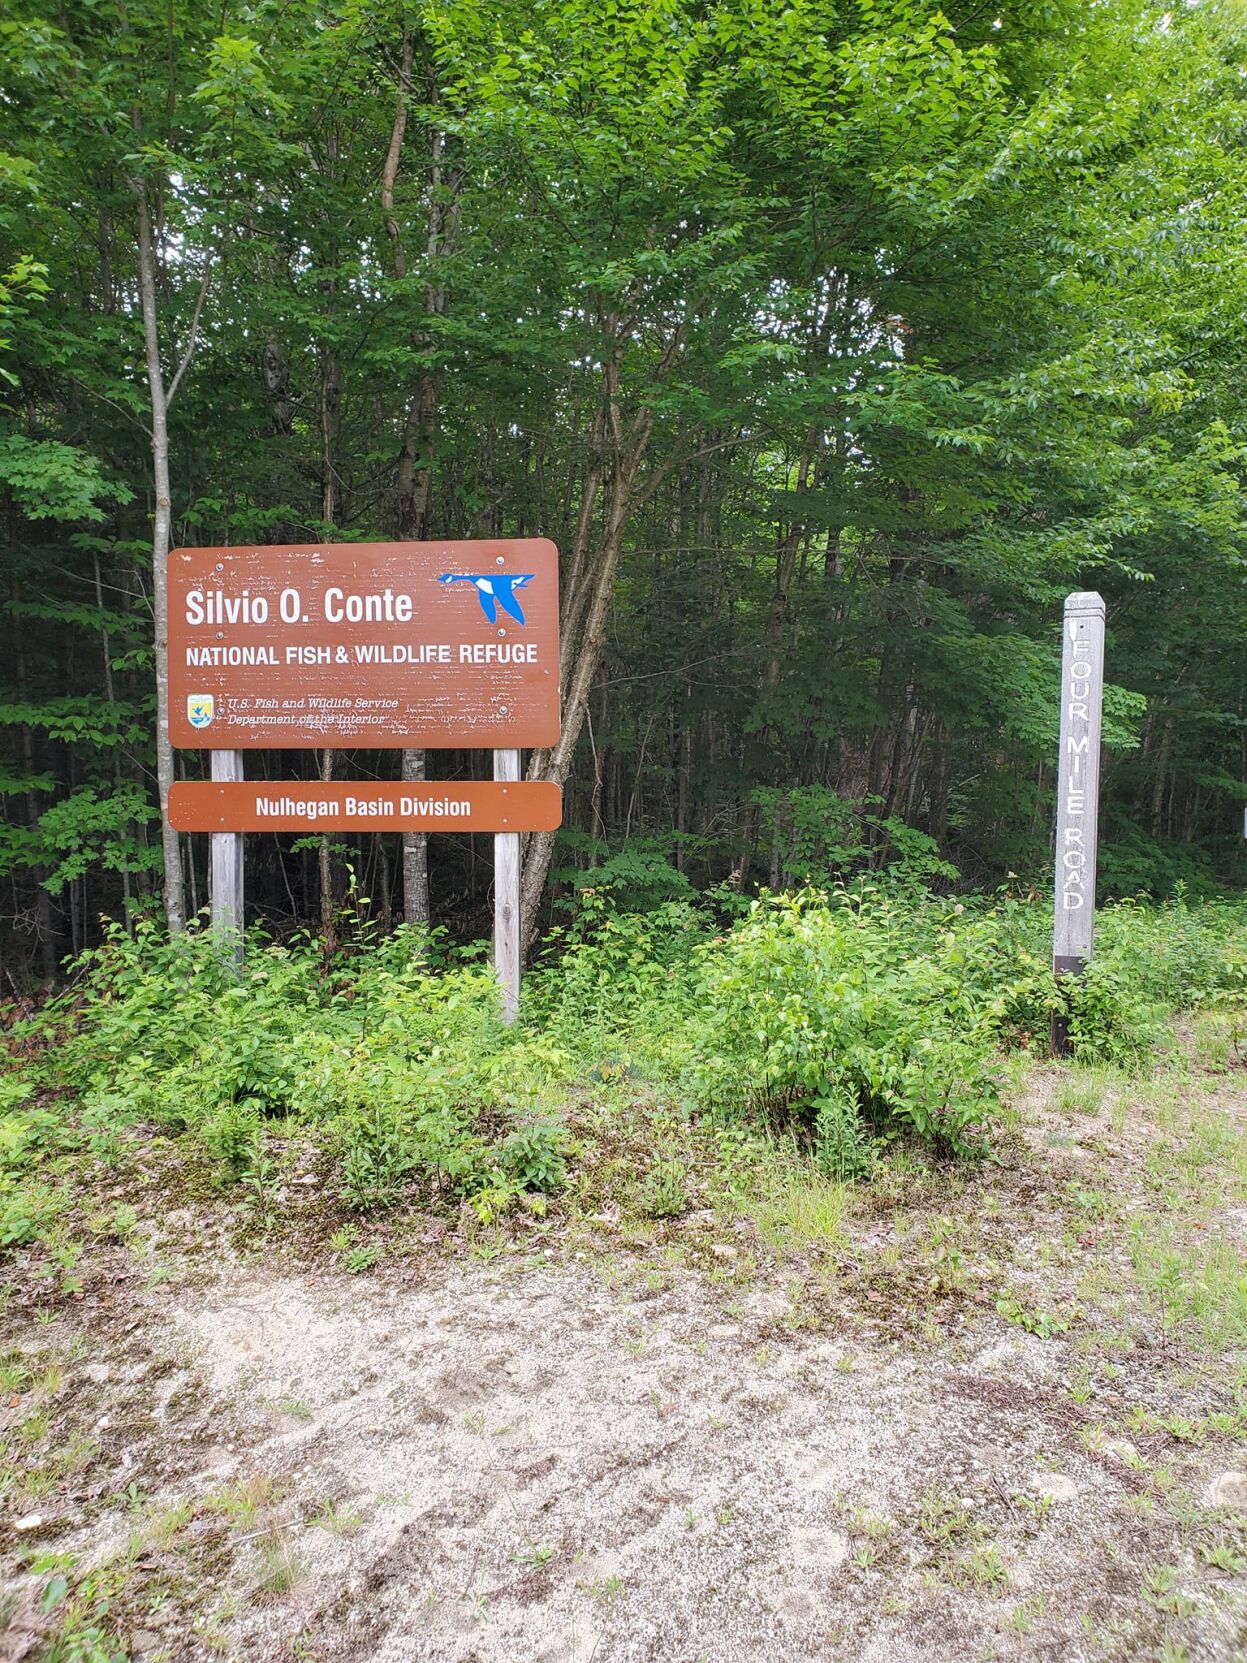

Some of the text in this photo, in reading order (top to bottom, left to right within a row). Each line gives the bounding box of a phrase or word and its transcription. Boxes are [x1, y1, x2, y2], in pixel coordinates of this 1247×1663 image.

[185, 588, 413, 626] Silvio O. Conte
[186, 644, 537, 666] NATIONAL FISH & WILDLIFE REFUGE
[228, 698, 399, 709] U.S. Fish and Wildlife Service
[227, 714, 386, 725] Department of the Interior
[1063, 640, 1091, 909] FOUR MILE ROAD
[256, 797, 471, 820] Nulhegan Basin Division
